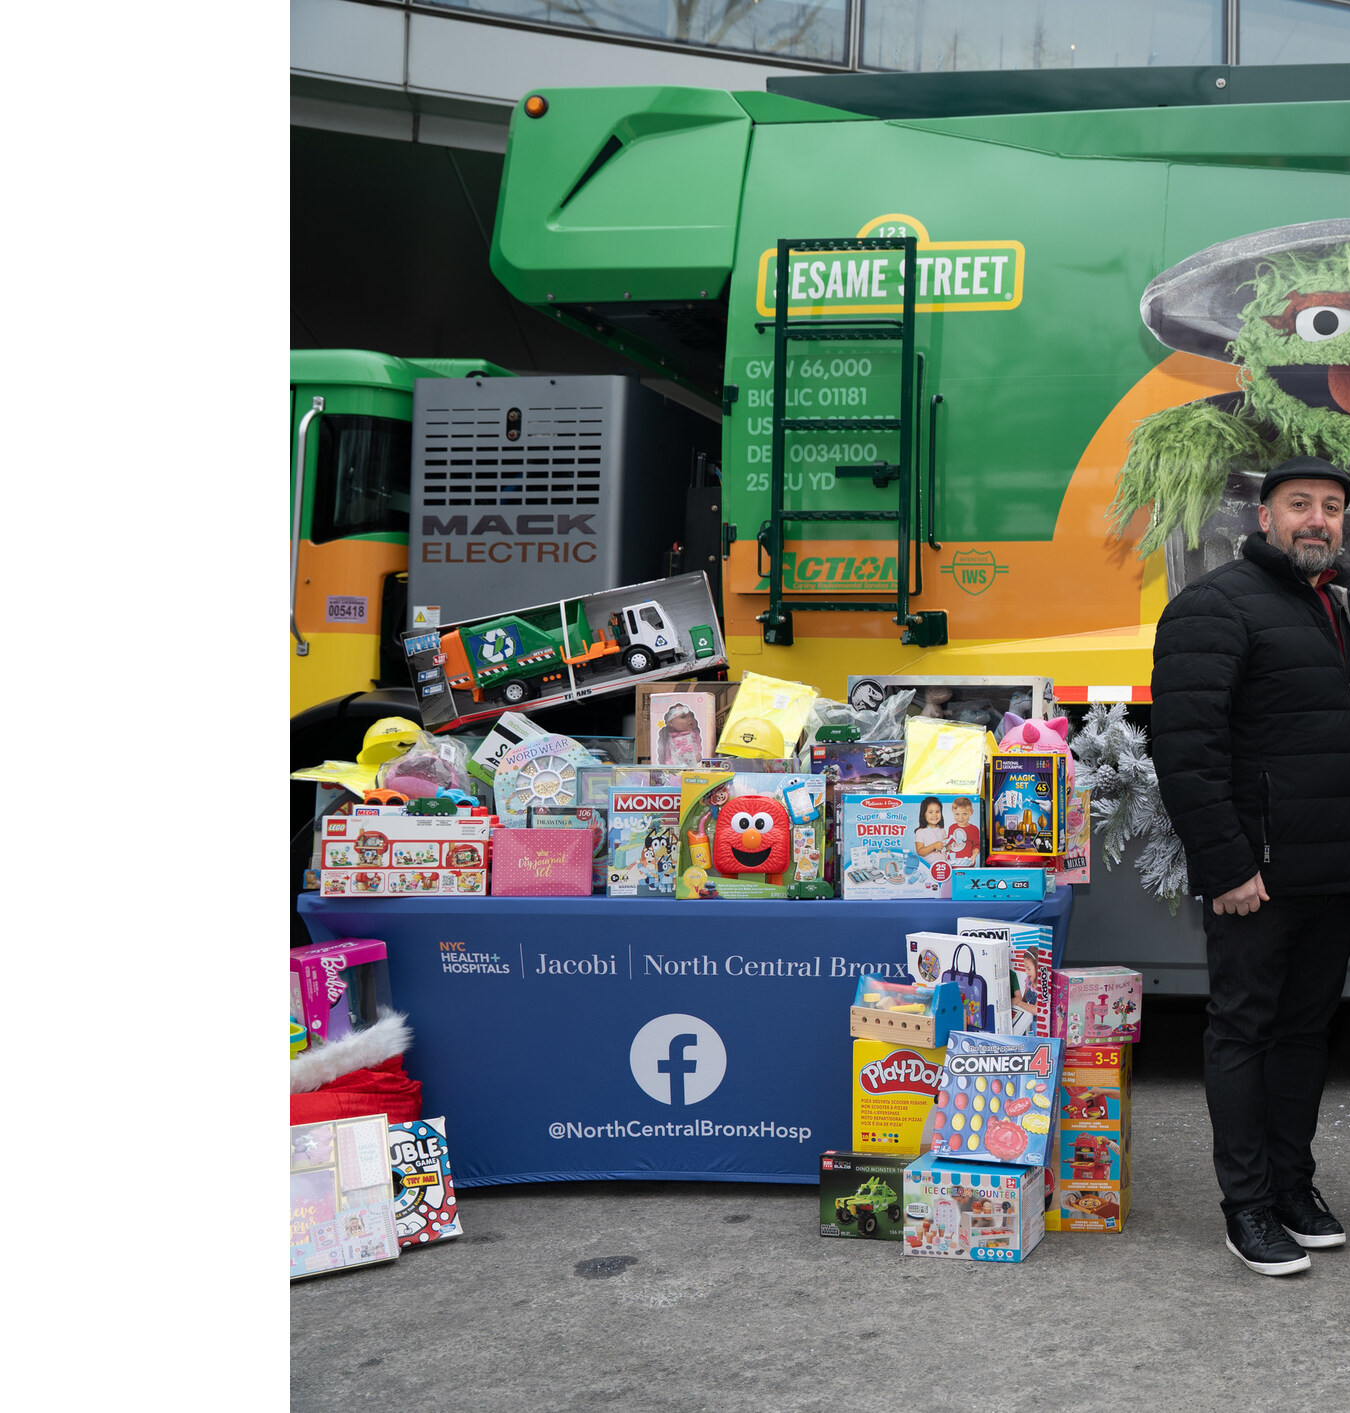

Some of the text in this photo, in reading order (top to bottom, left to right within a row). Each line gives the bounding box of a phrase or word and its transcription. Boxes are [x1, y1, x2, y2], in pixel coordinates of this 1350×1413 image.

[800, 359, 872, 380] 66,000
[818, 387, 867, 406] 01181
[747, 417, 774, 435] US
[790, 443, 878, 463] 0034100
[746, 473, 836, 492] 25 YD
[422, 514, 597, 536] MACK
[422, 541, 597, 564] ELECTRIC
[962, 570, 987, 584] IWS
[329, 604, 365, 617] 005418
[506, 747, 538, 765] WORD
[539, 738, 569, 755] WEAR
[814, 749, 826, 757] LEGO
[1009, 774, 1035, 782] MAGIC
[577, 808, 591, 818] 106
[857, 812, 908, 821] Super Smile
[327, 823, 346, 832] LEGO
[857, 824, 906, 836] DENTIST
[862, 838, 901, 848] Play Set
[533, 853, 566, 869] journal
[1066, 857, 1087, 868] MIXER
[535, 864, 552, 878] set
[439, 942, 466, 952] NYC
[443, 963, 511, 974] HOSPITALS
[536, 952, 618, 976] Jacobi
[643, 954, 908, 978] North Central Bronx
[320, 954, 347, 1003] Barbie
[951, 1045, 1051, 1076] CONNECT 4
[1095, 1052, 1118, 1065] 3-5
[862, 1055, 944, 1089] Play-Doh
[548, 1119, 812, 1143] @NorthCentralBronxHosp
[415, 1157, 437, 1168] GAME
[406, 1174, 436, 1185] TRY ME!
[925, 1186, 1016, 1199] ICE CREAM COUNTER
